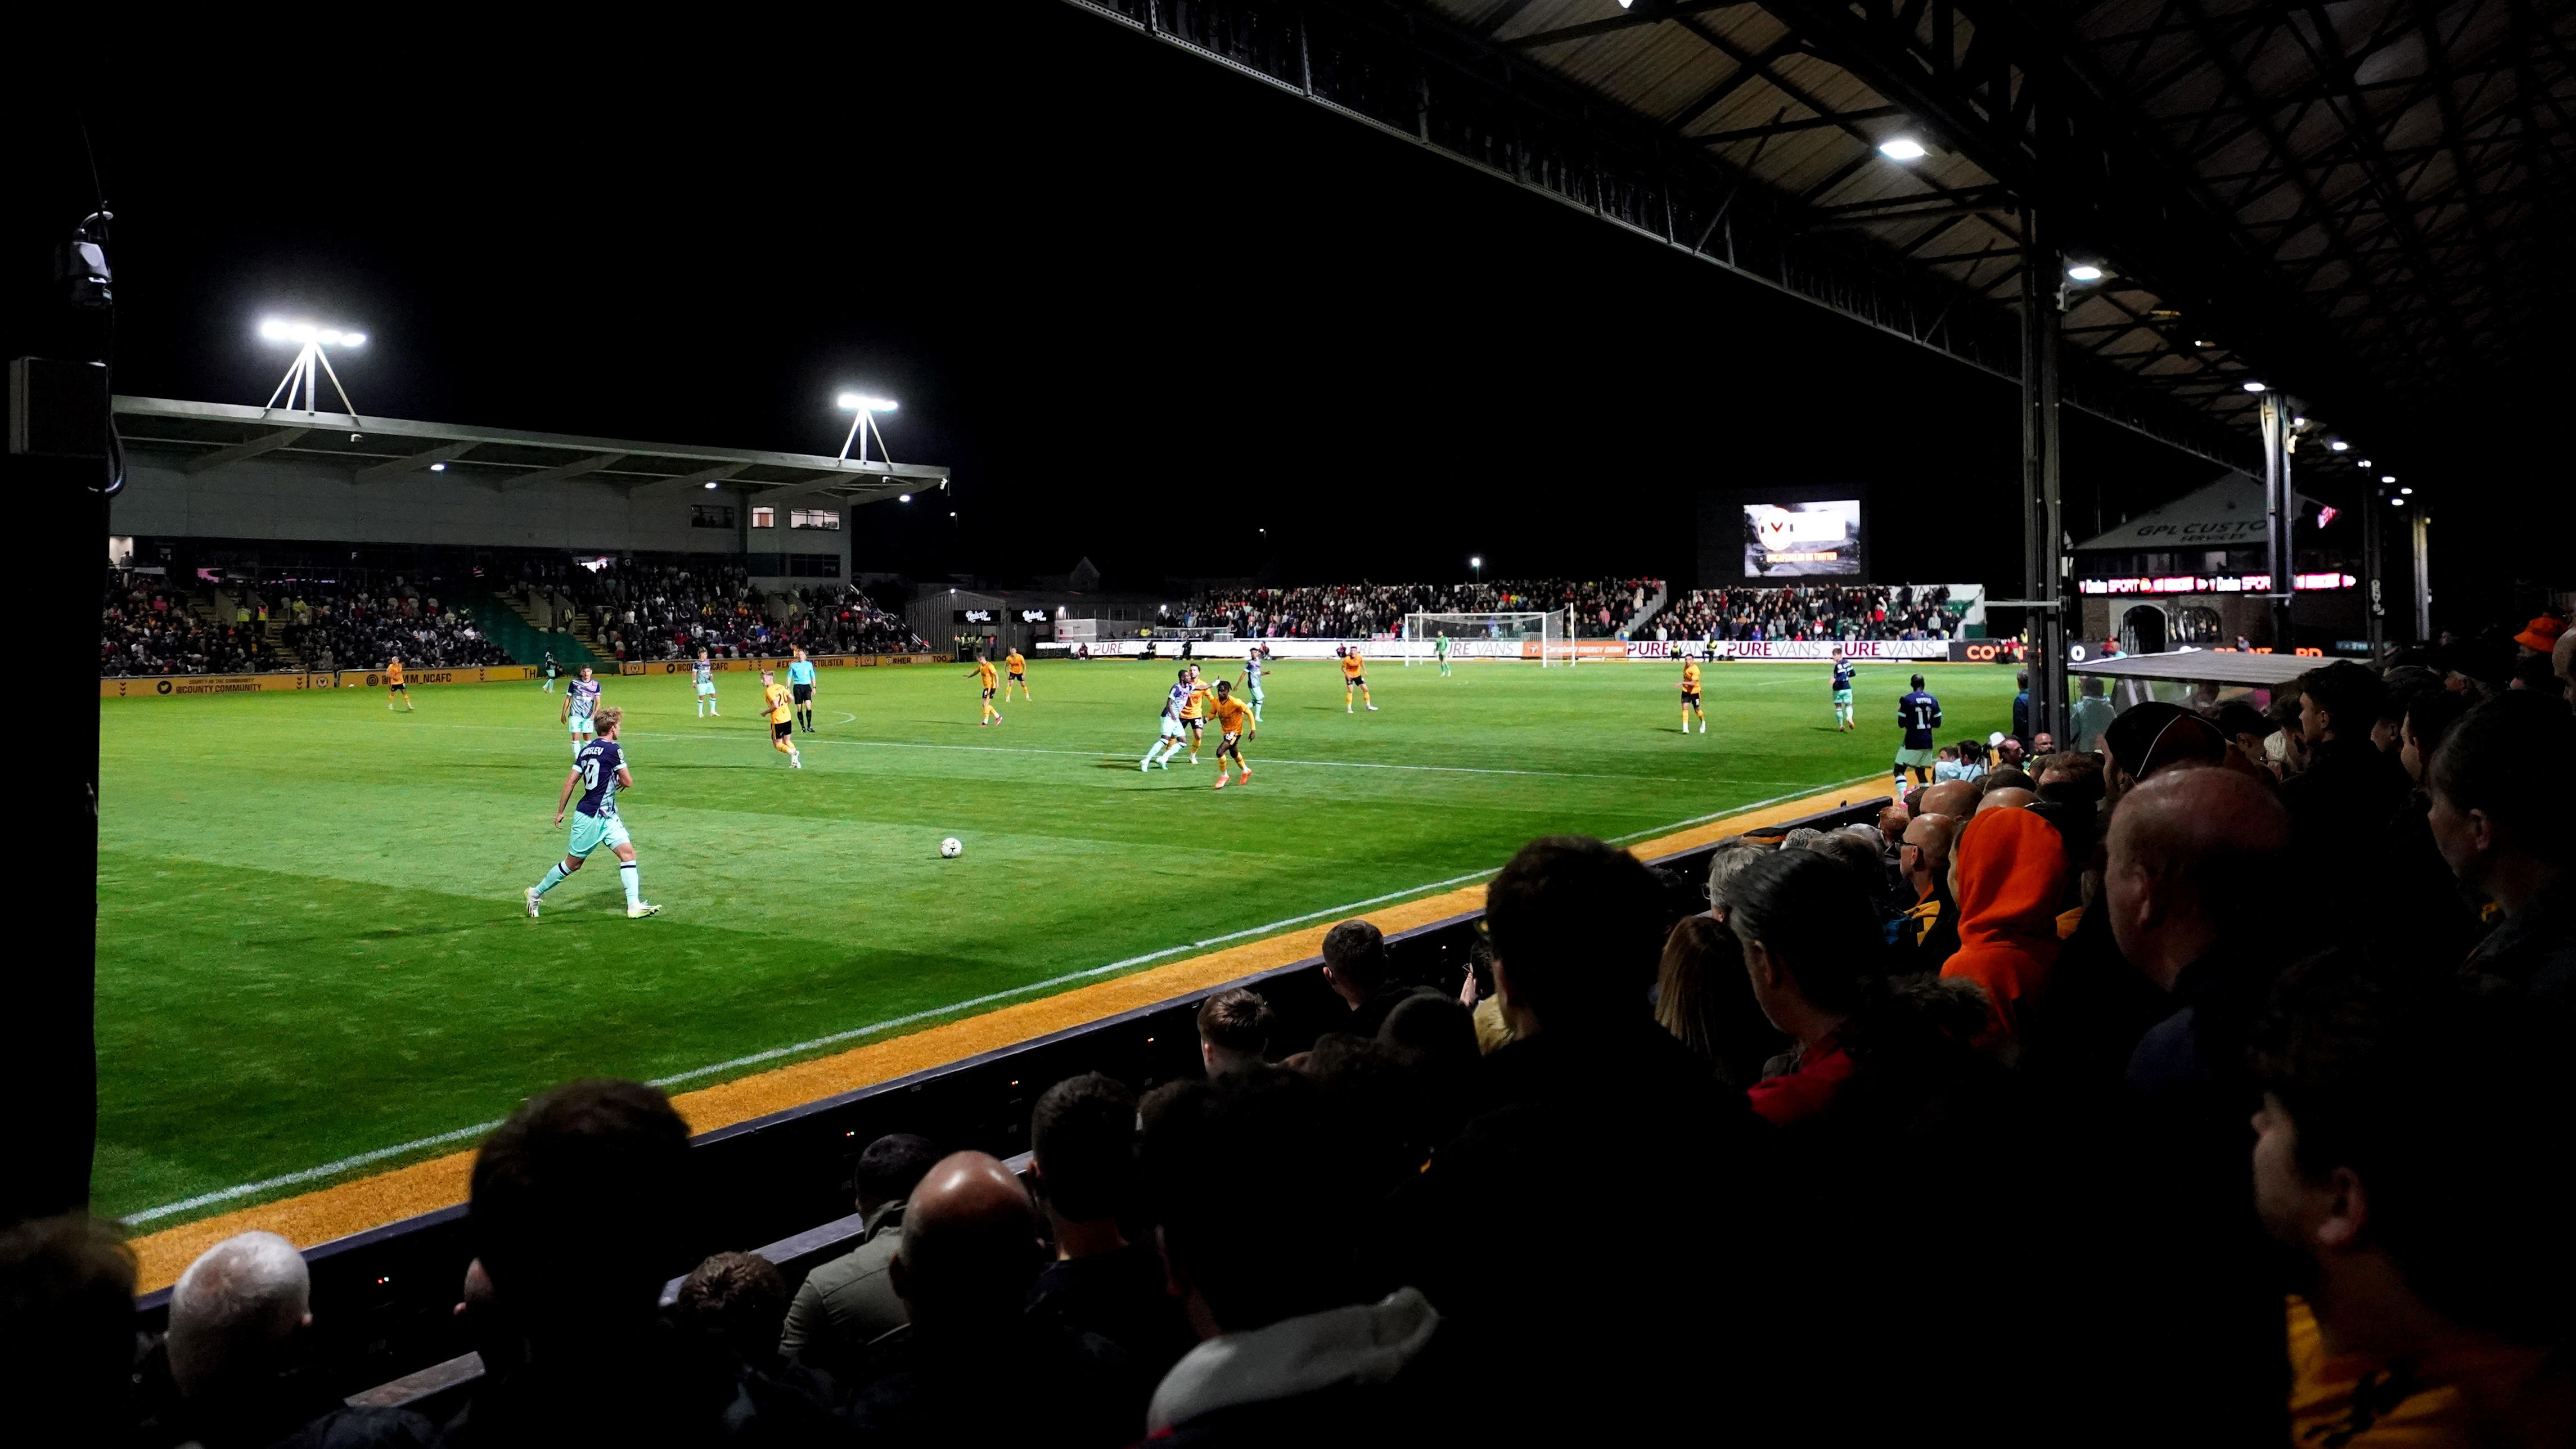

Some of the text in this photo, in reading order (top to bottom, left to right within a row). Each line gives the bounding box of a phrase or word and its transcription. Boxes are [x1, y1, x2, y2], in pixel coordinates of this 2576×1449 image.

[2183, 520, 2268, 534] CUSTO
[2241, 575, 2271, 591] SPOR
[1093, 642, 1124, 655] PURE
[1475, 642, 1514, 656] VANS
[1627, 642, 1669, 656] PURE
[1727, 642, 1821, 656] PURE VANS
[1885, 642, 1935, 656] VANS
[523, 668, 535, 680] TH
[215, 683, 262, 692] COMMUNITY
